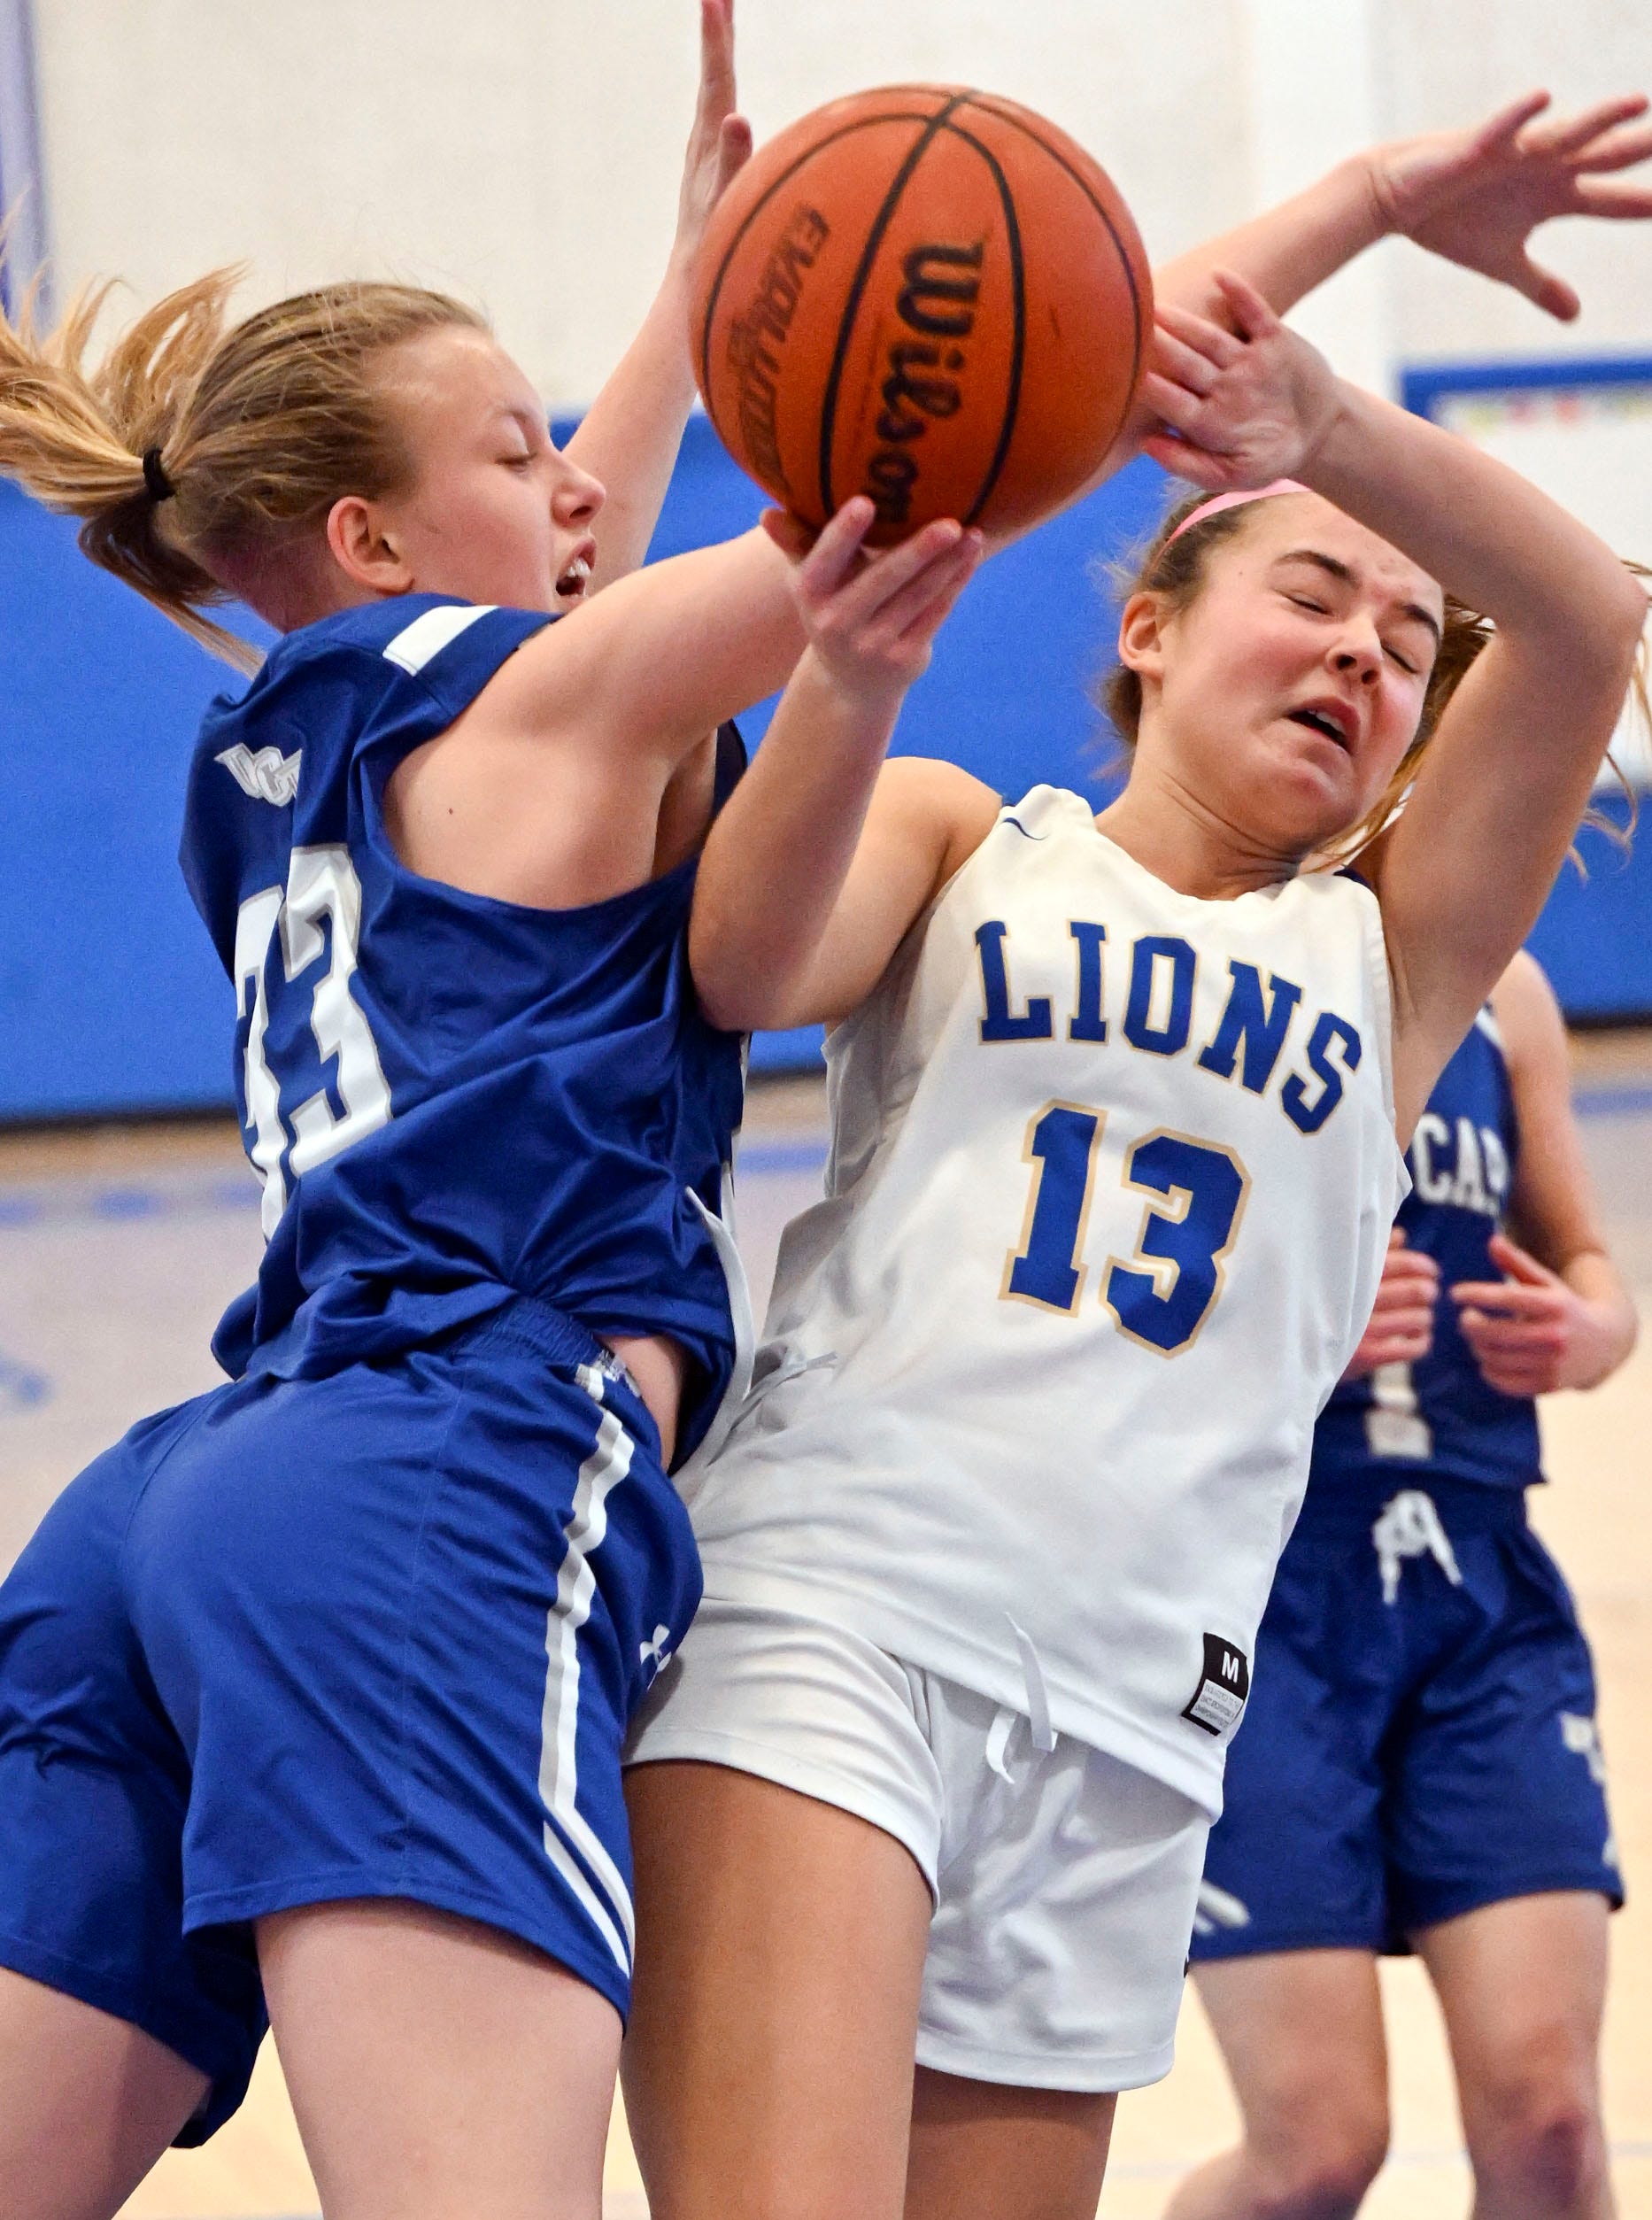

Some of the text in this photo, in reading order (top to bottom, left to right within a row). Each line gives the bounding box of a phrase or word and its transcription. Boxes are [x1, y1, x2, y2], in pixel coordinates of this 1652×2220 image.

[864, 237, 985, 523] Wilson
[973, 919, 1363, 1137] LIONS
[998, 1098, 1252, 1359] 13
[1222, 1650, 1239, 1683] M
